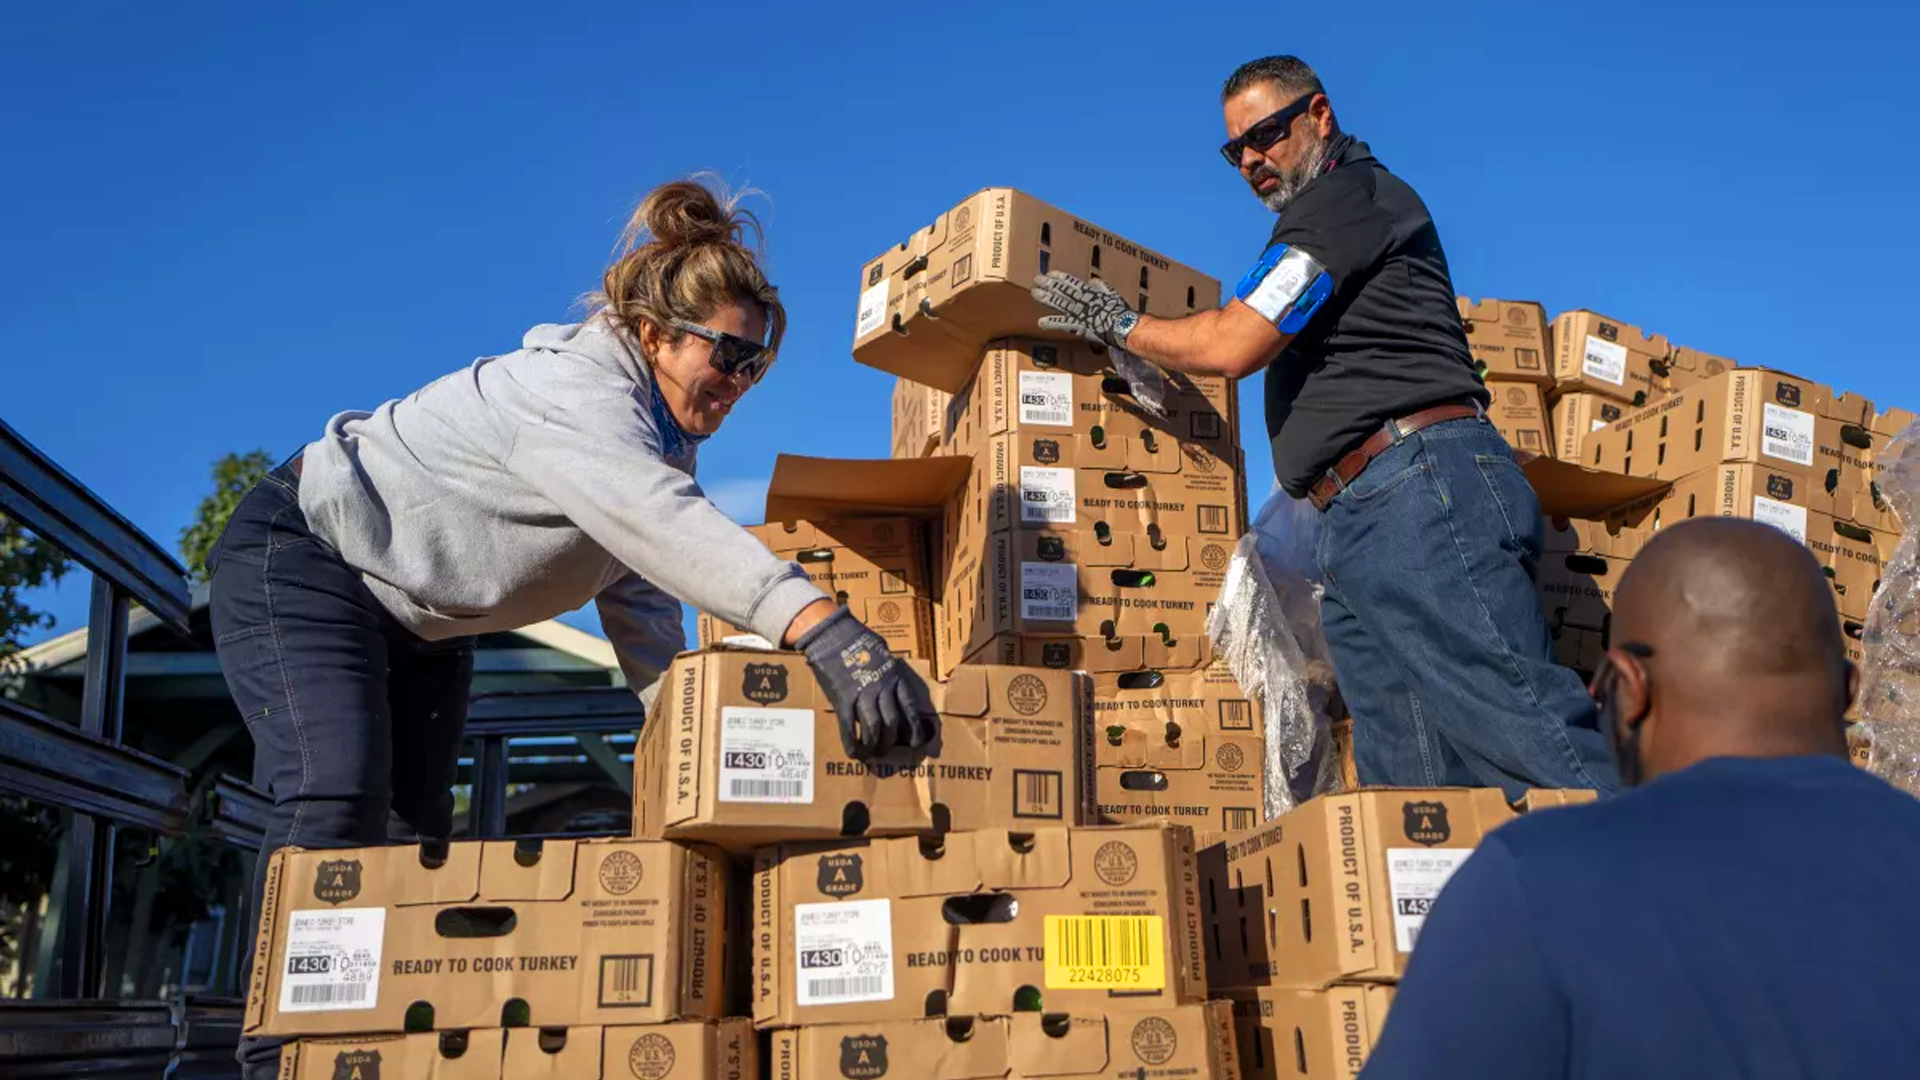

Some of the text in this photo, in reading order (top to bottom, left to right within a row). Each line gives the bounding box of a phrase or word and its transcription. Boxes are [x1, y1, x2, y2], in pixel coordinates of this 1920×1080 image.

[995, 219, 1004, 230] OF
[991, 232, 1003, 269] PRODUCT
[1073, 220, 1170, 271] READY TO COOK TURKEY
[1734, 376, 1745, 413] PRODUCT
[1615, 418, 1632, 432] READY
[1643, 405, 1659, 420] COOK
[1660, 396, 1684, 412] TURKEY
[1733, 415, 1743, 426] OF
[1723, 470, 1735, 509] PRODUCT
[1083, 498, 1185, 511] READY TO COOK TURKEY
[1812, 540, 1841, 555] READY
[1842, 548, 1853, 558] TO
[841, 571, 869, 580] TURKEY
[1585, 586, 1610, 599] COOK
[1089, 597, 1194, 610] READY TO COOK TURKEY
[755, 668, 778, 676] USDA
[760, 677, 770, 689] A
[750, 691, 780, 699] GRADE
[1094, 699, 1206, 711] READY TO COOK TURKEY
[677, 667, 695, 805] PRODUCT OF U.S.A.
[826, 761, 993, 781] READY TO COOK TURKEY
[1130, 805, 1141, 814] TO
[1145, 805, 1171, 815] COOK
[1173, 806, 1209, 816] TURKEY
[1413, 806, 1438, 814] USDA
[1420, 816, 1433, 829] A
[1413, 832, 1445, 840] GRADE
[828, 858, 853, 867] USDA
[332, 874, 344, 887] A
[834, 868, 847, 881] A
[1338, 806, 1365, 953] PRODUCT OF U.S.A.
[321, 889, 353, 898] GRADE
[825, 884, 857, 893] GRADE
[262, 865, 278, 935] PRODUCT
[1185, 887, 1195, 906] OF
[694, 904, 707, 923] OF
[760, 859, 771, 1002] PRODUCT OF U.S.A.
[260, 941, 267, 958] OF
[1187, 912, 1201, 981] PRODUCT
[956, 948, 975, 964] TO
[980, 947, 1021, 963] COOK
[392, 959, 443, 976] READY
[448, 957, 467, 973] TO
[473, 957, 515, 973] COOK
[519, 955, 578, 971] TURKEY
[692, 928, 707, 999] PRODUCT
[1069, 968, 1141, 983] 22428075
[851, 1040, 878, 1049] USDA
[1342, 1000, 1363, 1075] PRODUC
[345, 1056, 371, 1064] USDA
[781, 1039, 791, 1080] PROD
[858, 1050, 870, 1064] A
[351, 1066, 362, 1080] A
[849, 1067, 881, 1076] GRADE
